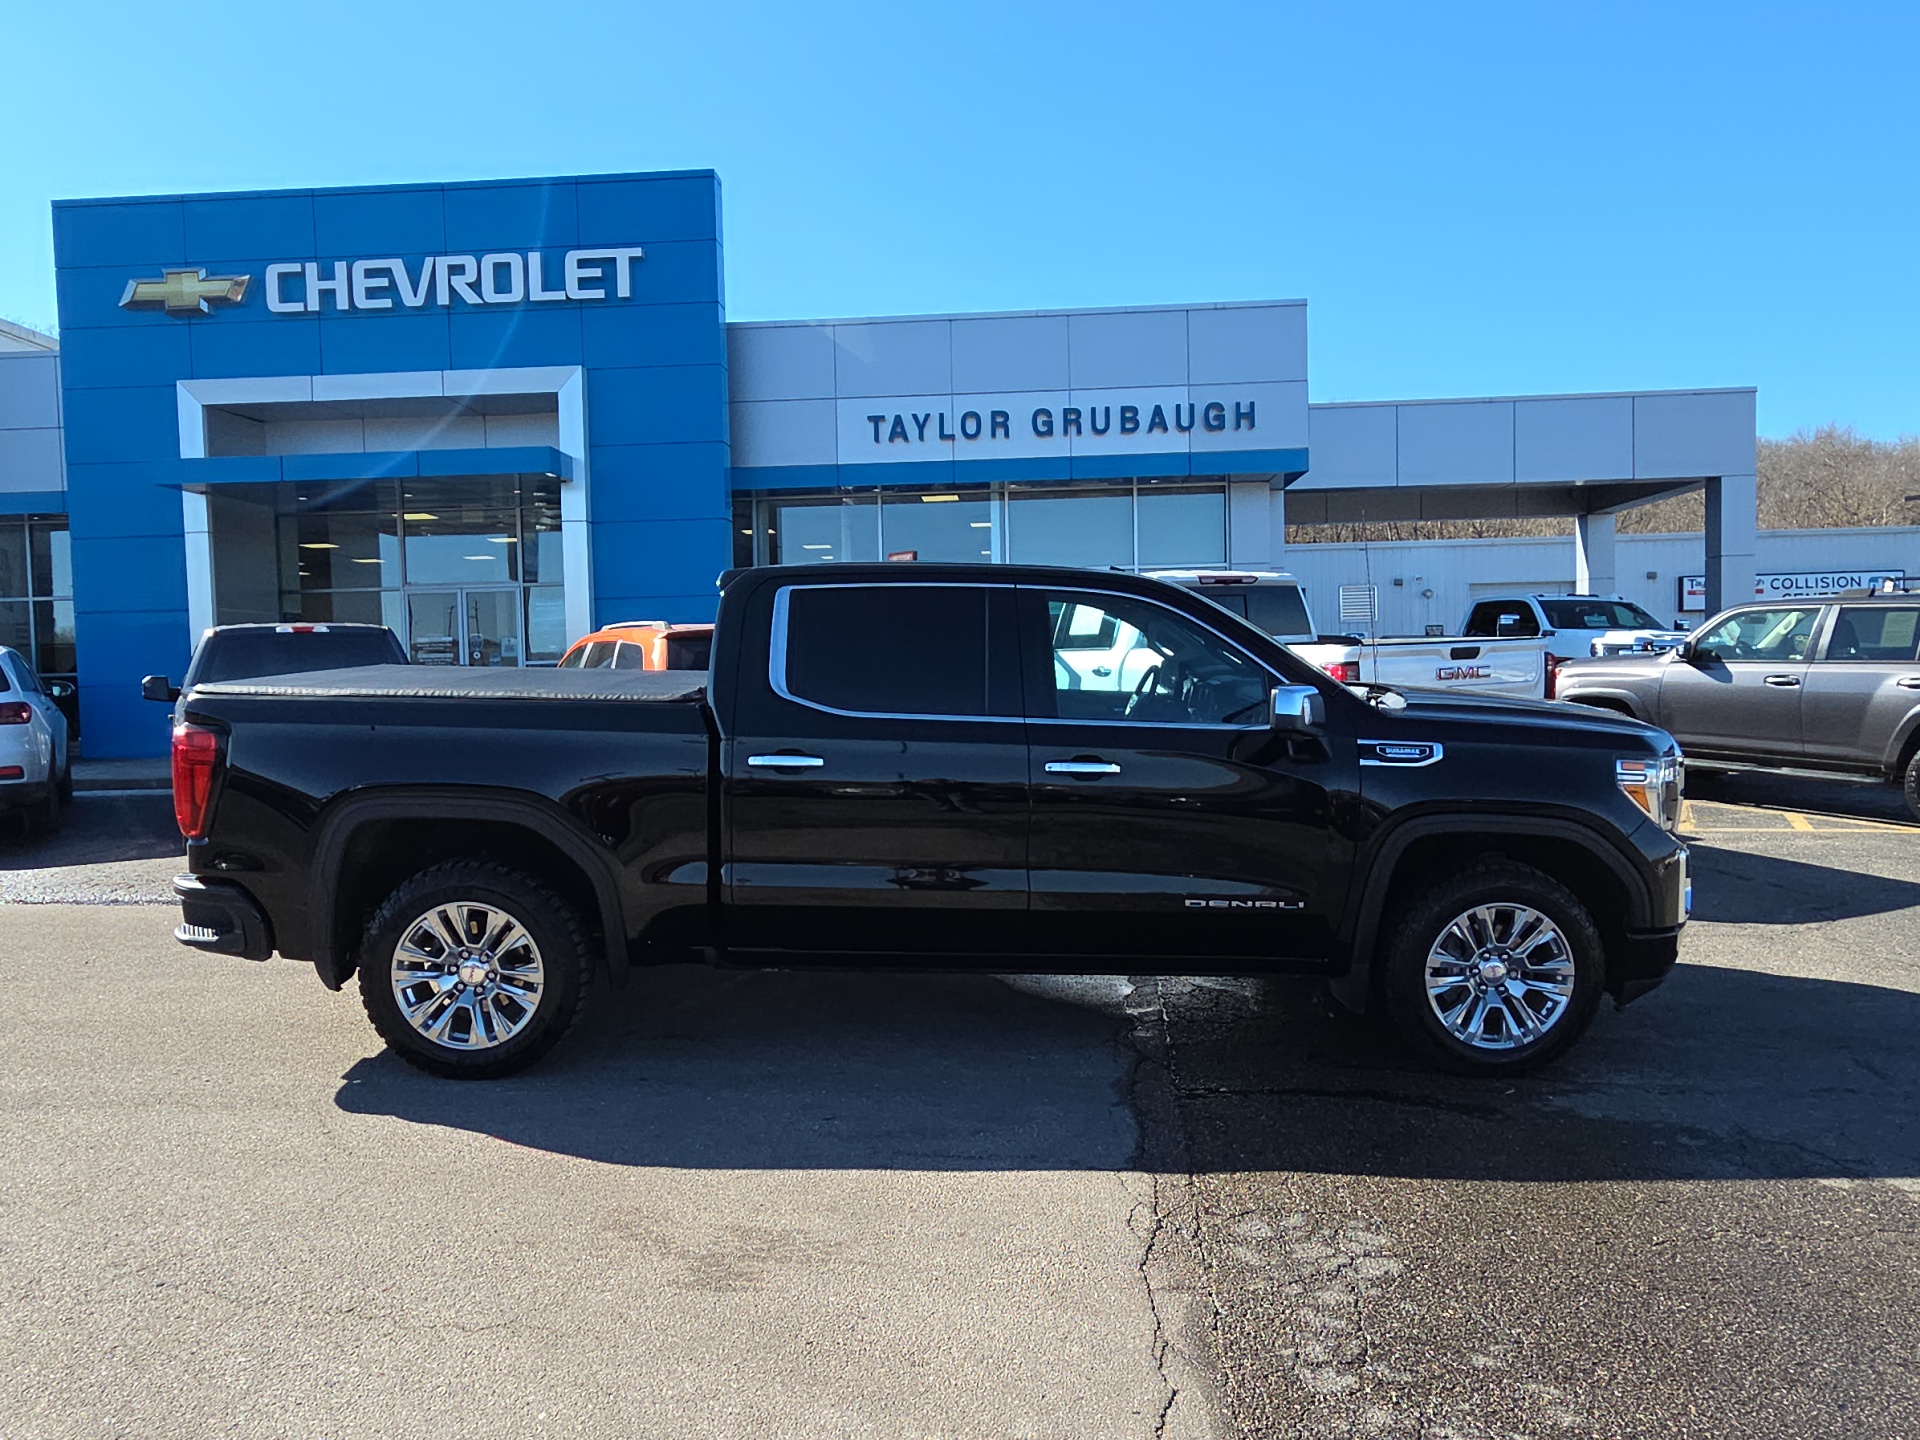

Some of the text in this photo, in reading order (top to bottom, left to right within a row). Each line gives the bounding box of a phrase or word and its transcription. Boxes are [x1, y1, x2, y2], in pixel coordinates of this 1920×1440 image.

[265, 247, 643, 313] CHEVROLET
[867, 401, 1257, 443] TAYLOR GRUBAUGH
[1770, 576, 1862, 590] COLLISION
[1436, 665, 1491, 681] GMC
[1185, 900, 1304, 908] DENALI
